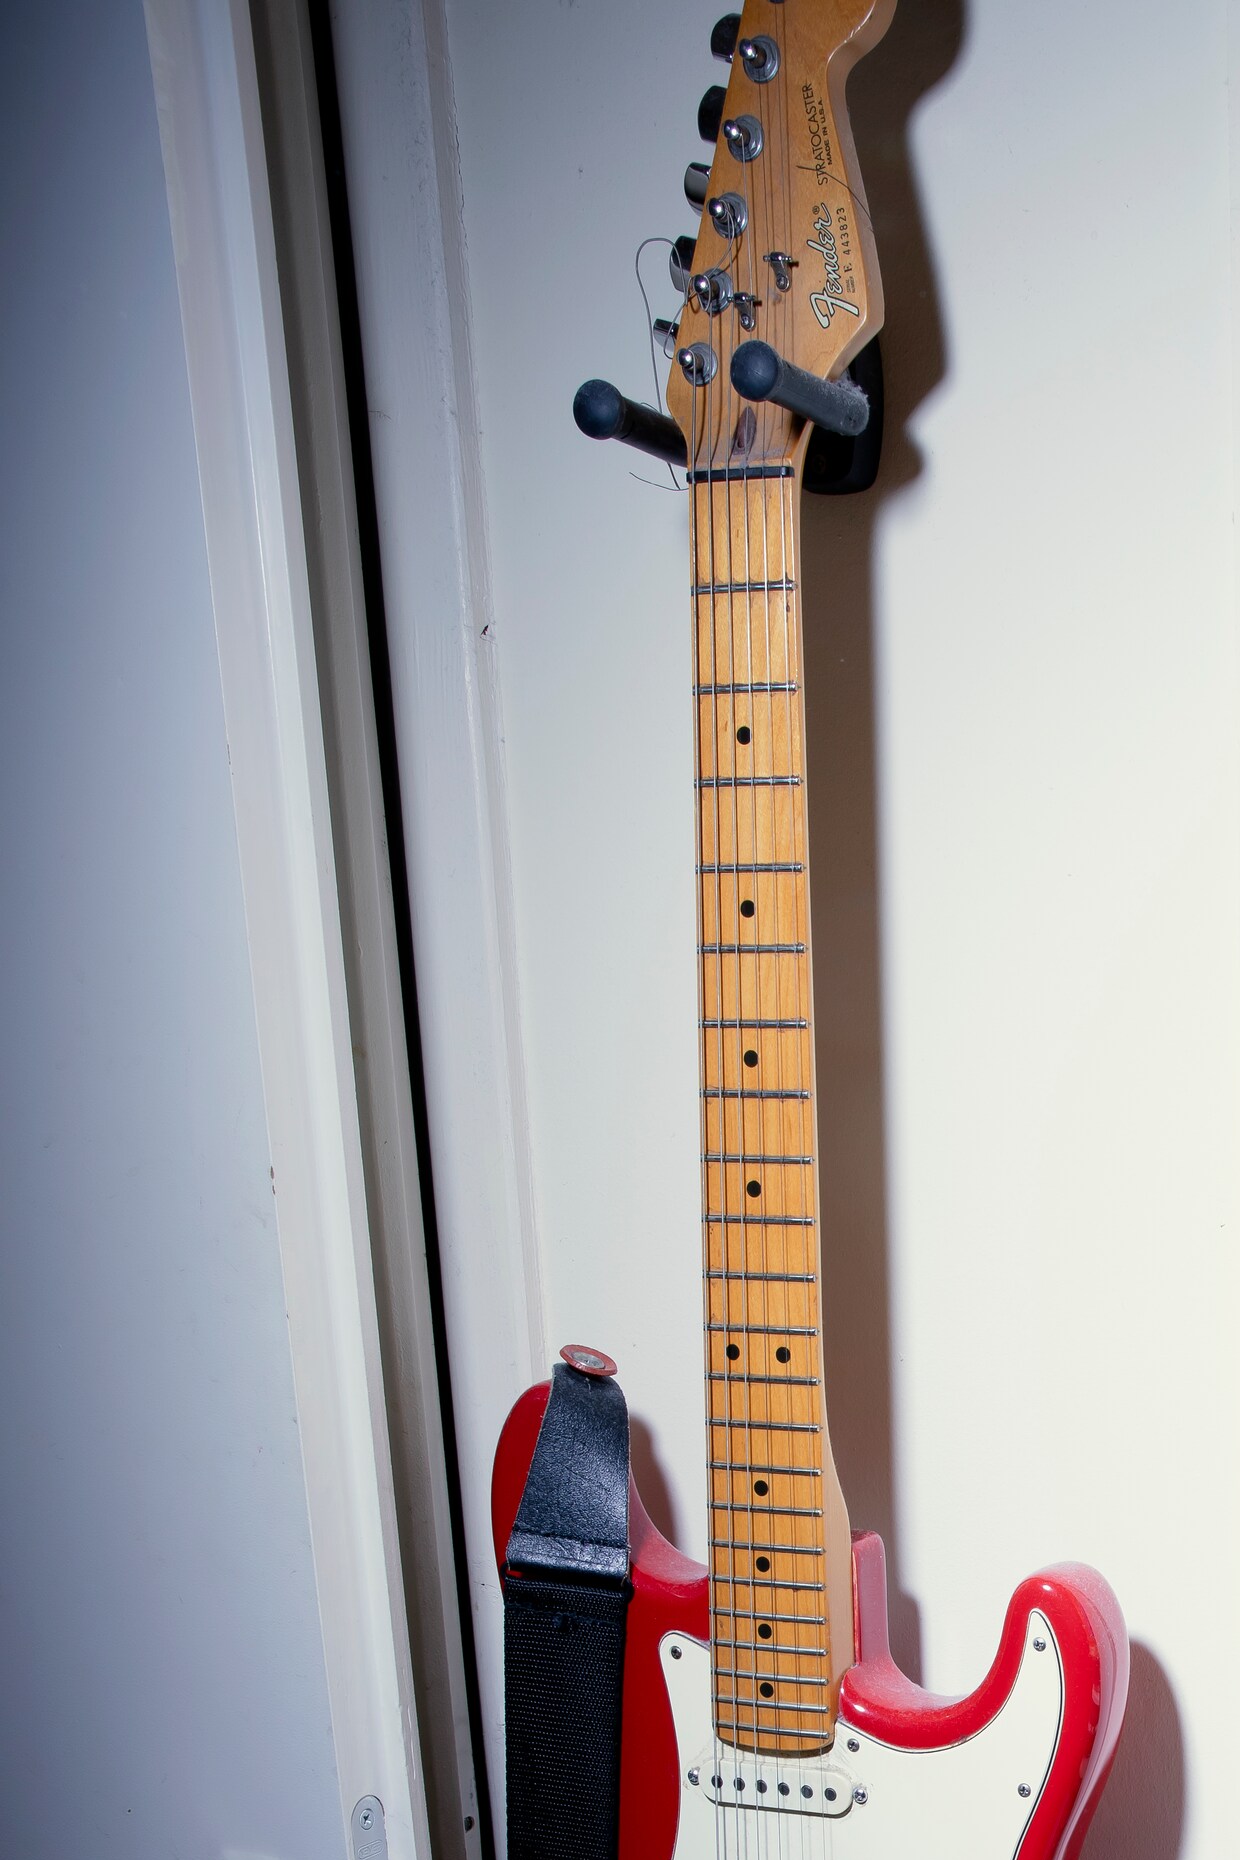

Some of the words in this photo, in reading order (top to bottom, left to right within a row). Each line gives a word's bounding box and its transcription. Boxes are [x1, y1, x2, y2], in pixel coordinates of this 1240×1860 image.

[803, 82, 828, 187] STRATOCASTER
[821, 125, 829, 138] IN
[825, 139, 834, 165] MADE
[836, 206, 850, 256] 443823
[807, 202, 860, 329] Fender
